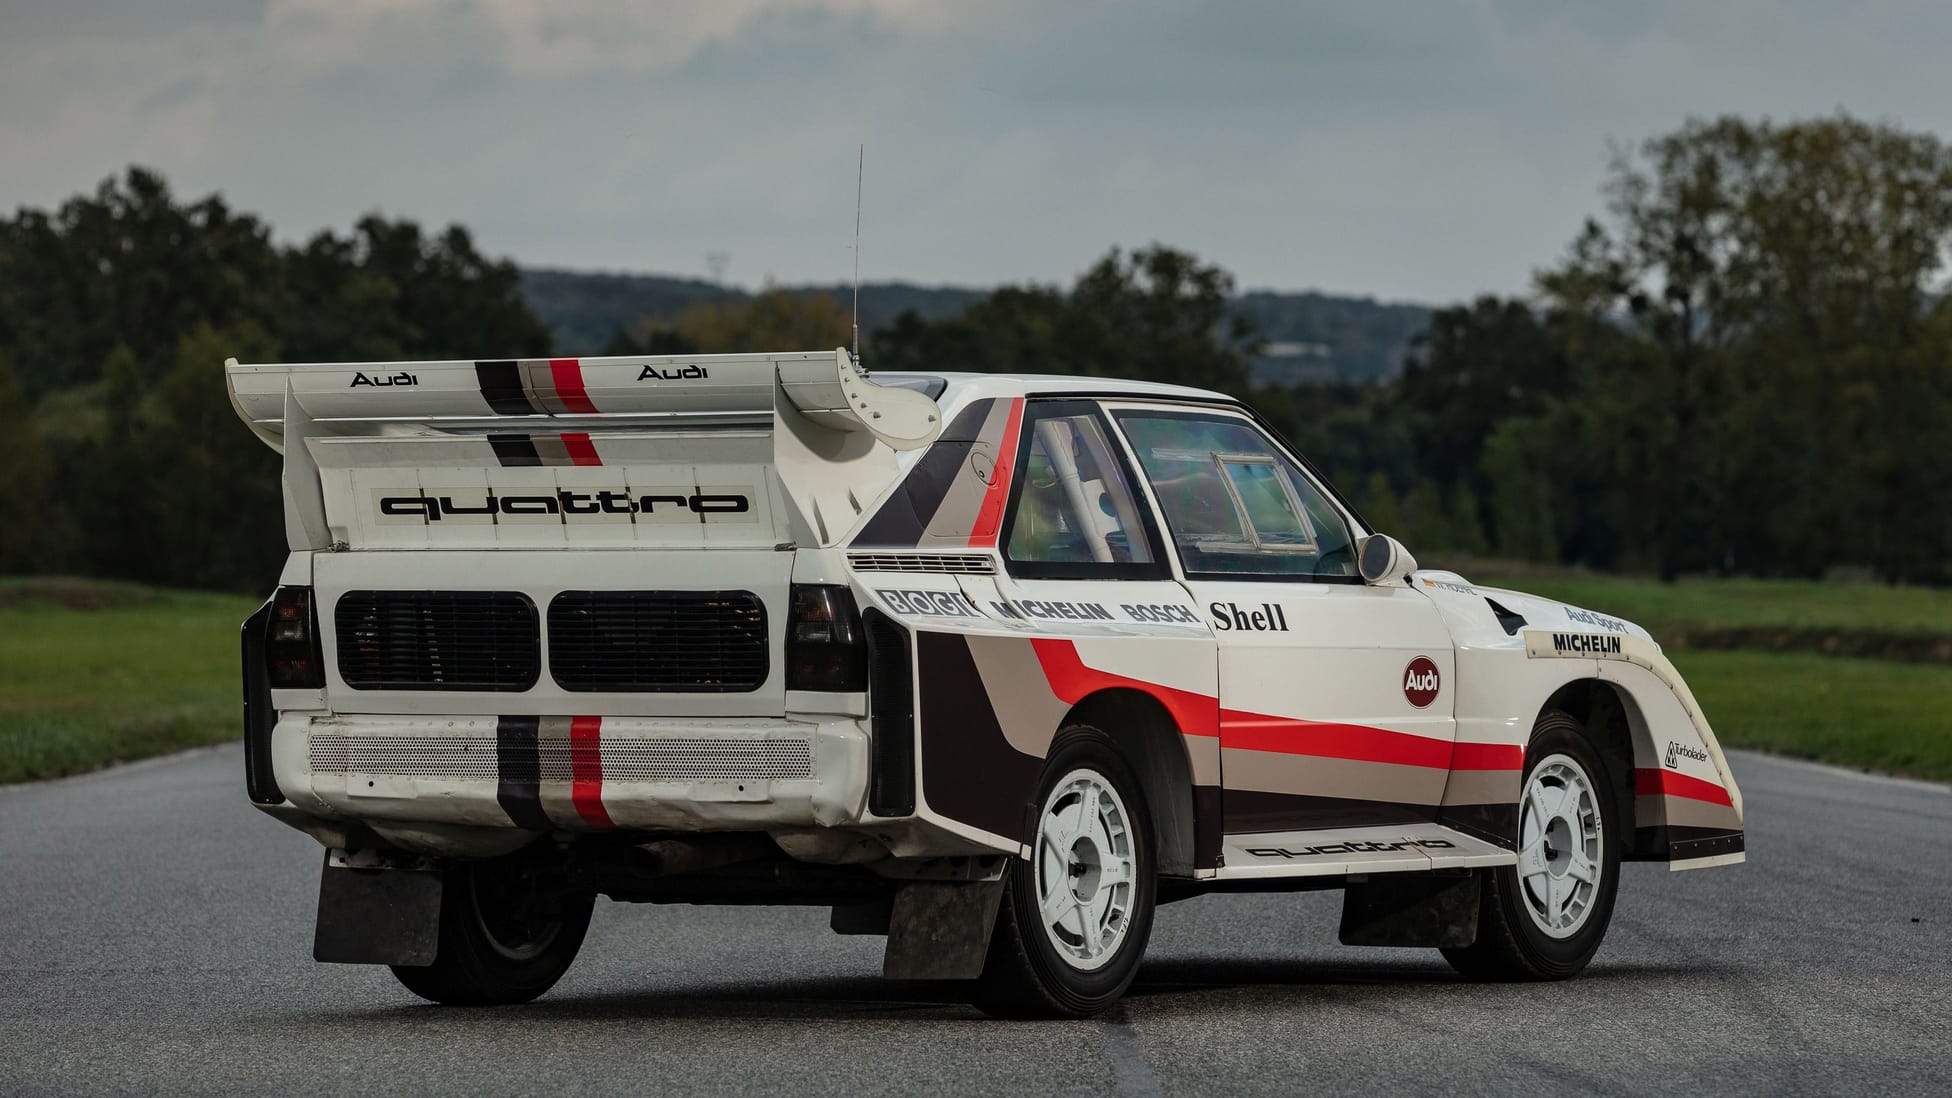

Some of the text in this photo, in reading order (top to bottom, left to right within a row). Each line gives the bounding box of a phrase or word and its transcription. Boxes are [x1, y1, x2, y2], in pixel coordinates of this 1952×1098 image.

[350, 372, 419, 388] Audi
[638, 365, 709, 382] Audi
[380, 490, 749, 520] quattro
[989, 600, 1115, 621] MICHELIN
[1120, 604, 1201, 622] BOSCH
[1210, 602, 1290, 632] Shell
[1563, 606, 1629, 634] Audi Sport
[1553, 633, 1621, 653] MICHELIN
[1405, 669, 1438, 691] Audi
[1245, 839, 1456, 858] quattro
